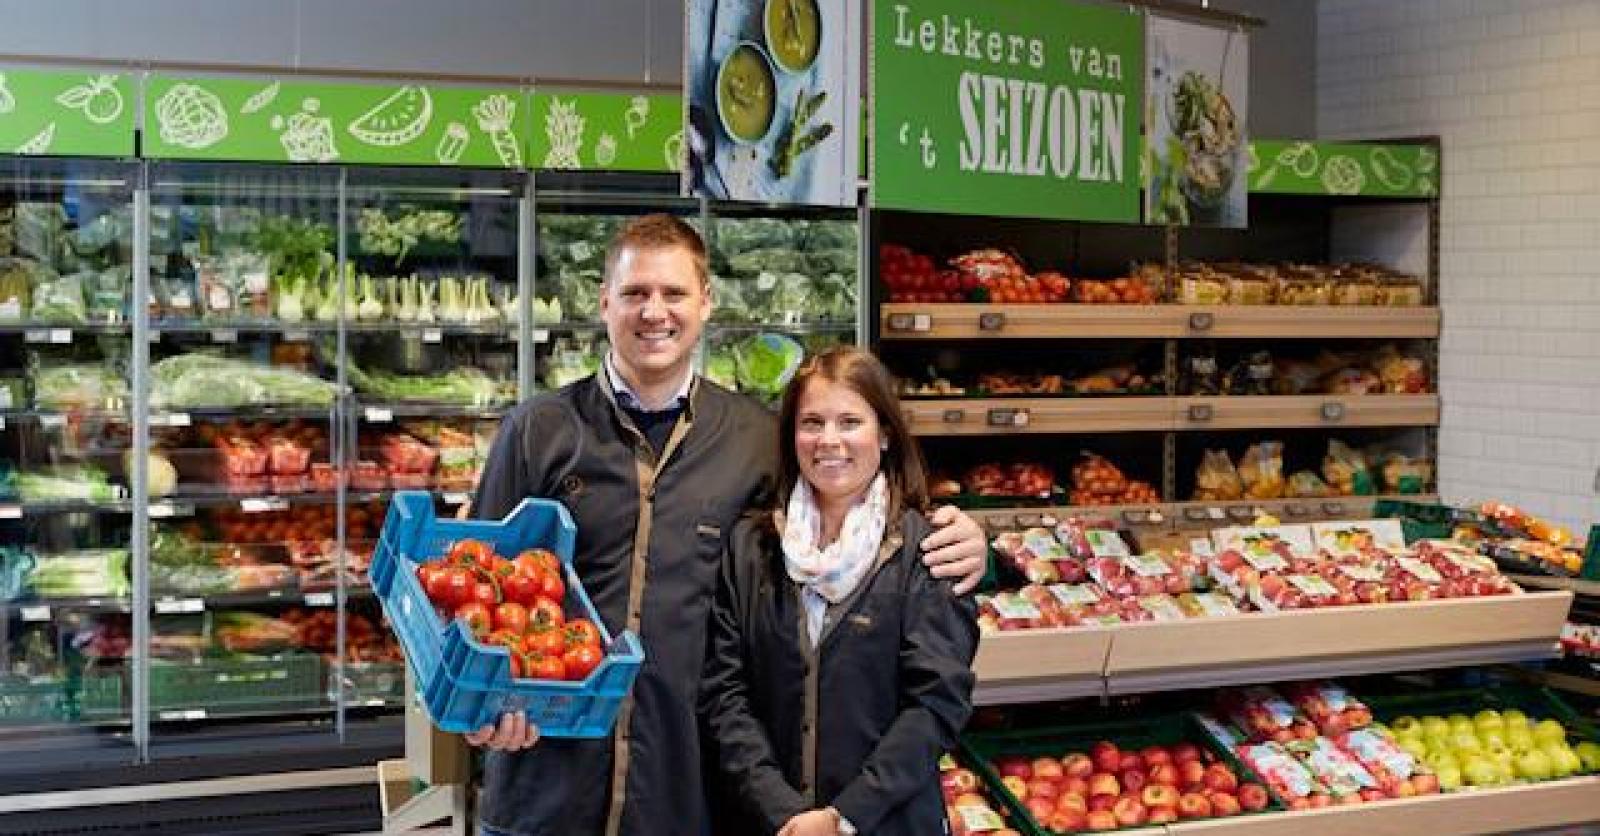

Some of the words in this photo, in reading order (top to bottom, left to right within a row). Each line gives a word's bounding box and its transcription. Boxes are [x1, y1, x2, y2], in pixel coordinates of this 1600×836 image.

[894, 4, 1044, 68] Lekkers
[1069, 46, 1122, 80] van
[958, 71, 1126, 183] SEIZOEN
